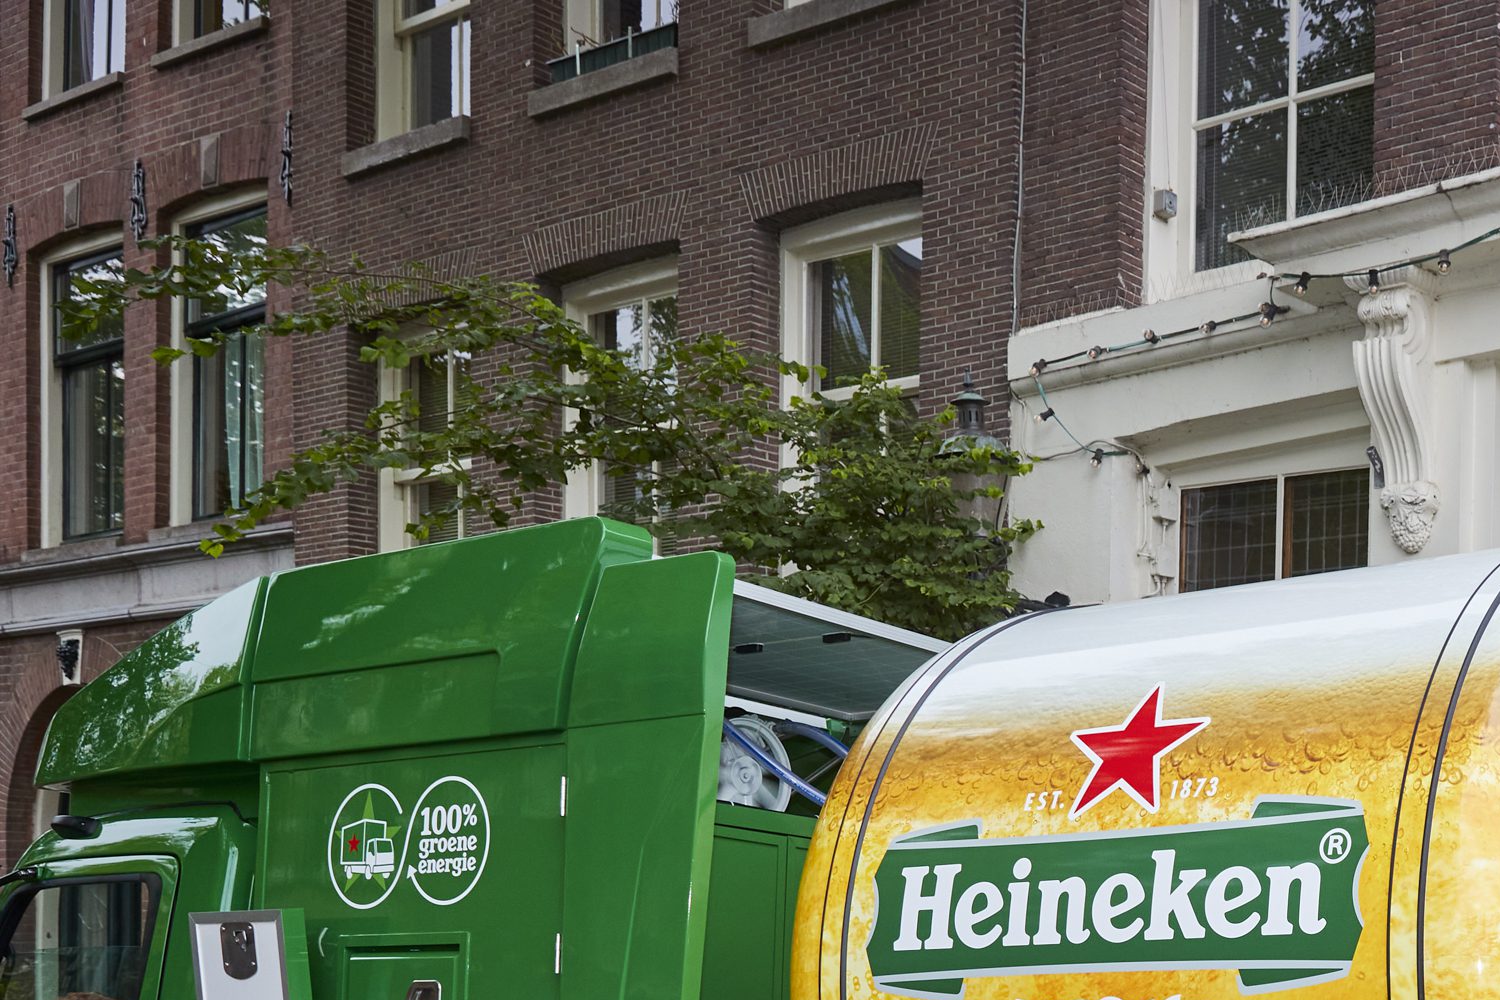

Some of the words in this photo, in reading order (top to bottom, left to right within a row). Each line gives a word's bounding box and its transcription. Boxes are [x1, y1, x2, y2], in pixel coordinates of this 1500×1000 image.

[1023, 789, 1066, 813] EST.
[1169, 776, 1220, 800] 1873
[420, 803, 478, 836] 100%
[418, 834, 478, 859] groene
[417, 852, 477, 877] energie
[893, 848, 1328, 952] Heineken
